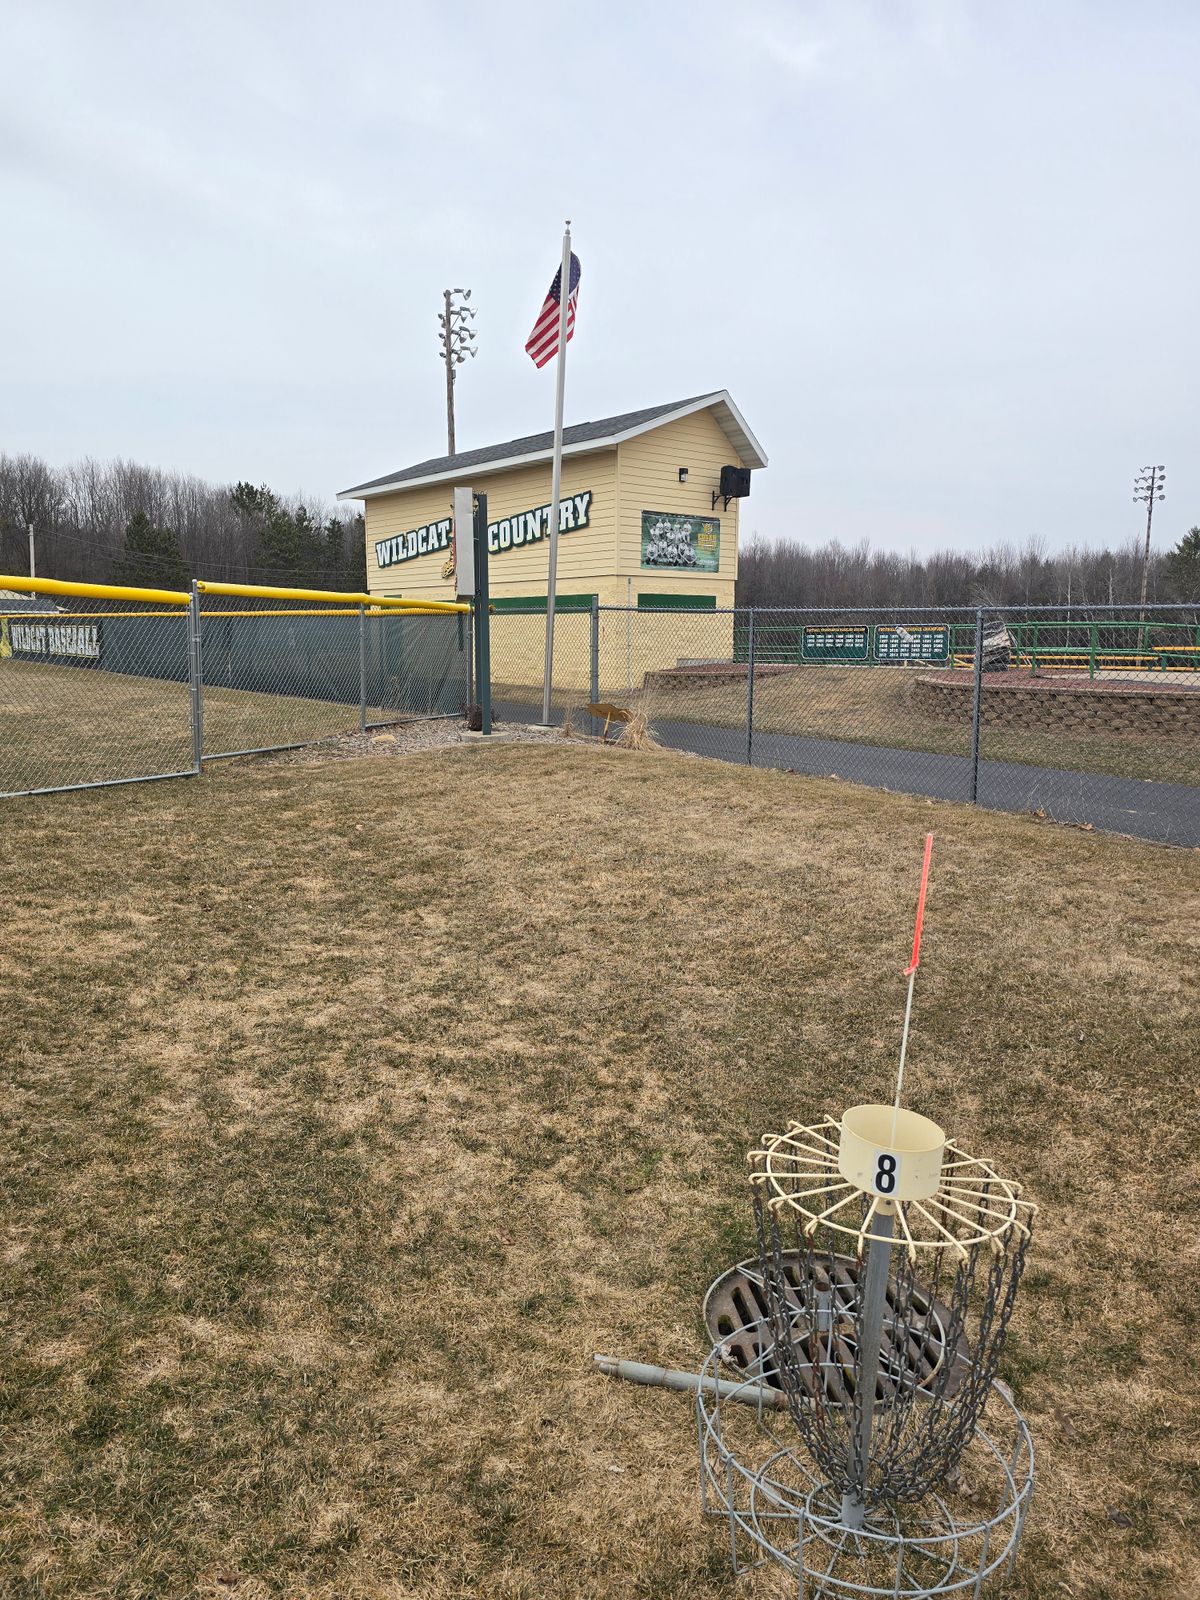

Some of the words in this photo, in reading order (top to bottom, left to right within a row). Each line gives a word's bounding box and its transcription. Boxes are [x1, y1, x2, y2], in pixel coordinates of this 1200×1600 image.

[376, 519, 450, 567] WILDCAT
[487, 492, 591, 553] COUNTRY
[875, 1154, 897, 1194] 8
